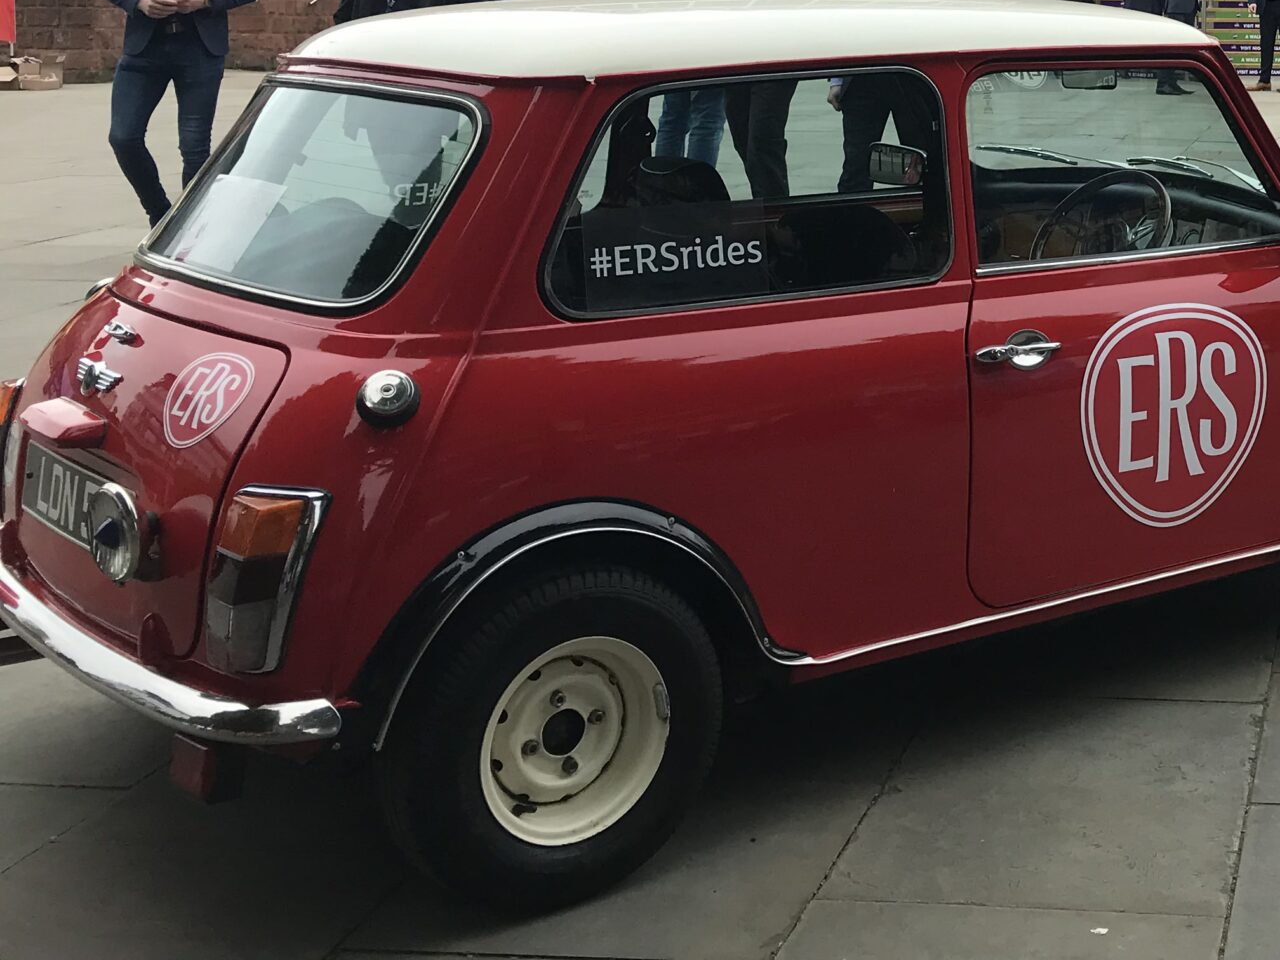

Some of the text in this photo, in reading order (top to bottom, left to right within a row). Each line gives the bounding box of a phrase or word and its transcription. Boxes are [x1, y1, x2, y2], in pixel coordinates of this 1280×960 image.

[589, 236, 762, 278] #ERSrides
[170, 362, 242, 430] ERS
[1116, 330, 1238, 483] ERS
[36, 456, 79, 532] LDN
